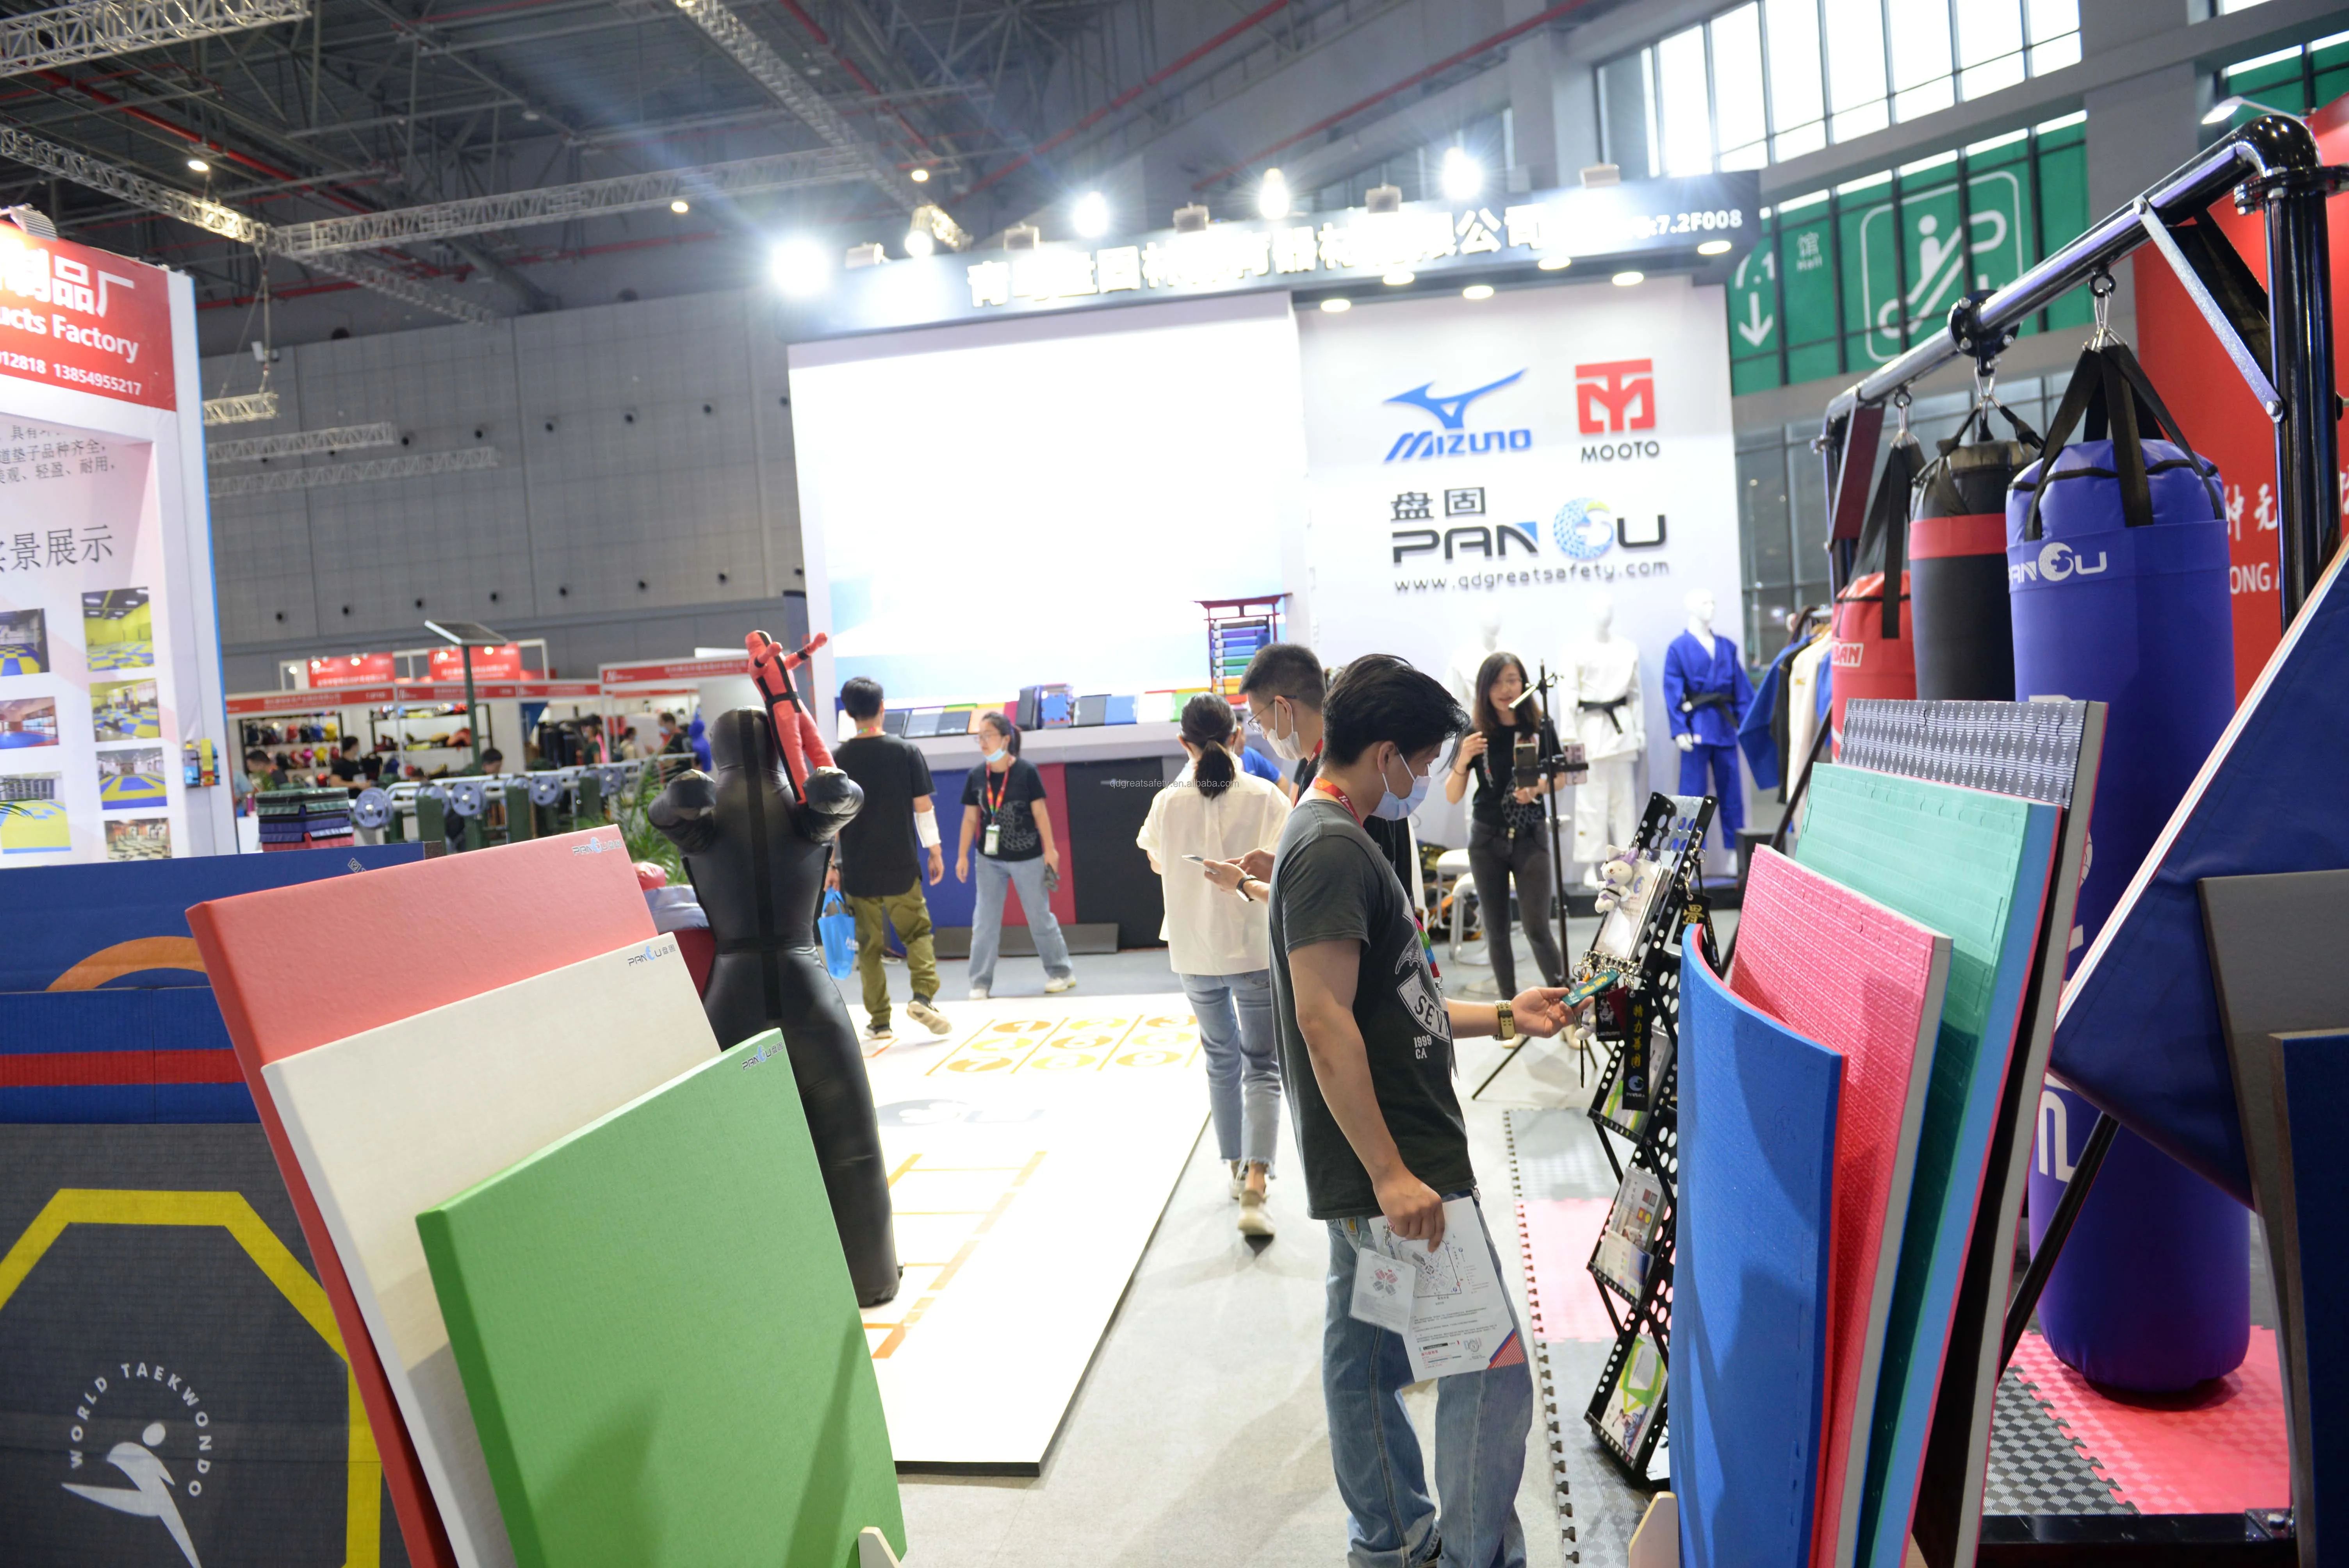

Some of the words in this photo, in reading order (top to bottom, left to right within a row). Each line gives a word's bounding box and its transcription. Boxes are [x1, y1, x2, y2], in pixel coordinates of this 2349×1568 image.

[52, 314, 139, 363] Factory
[0, 351, 46, 374] 12818
[53, 363, 142, 395] 13854955217
[1581, 441, 1660, 463] MOOTO
[1391, 486, 1486, 521] 盘固
[0, 524, 113, 573] 景展示
[1395, 560, 1670, 593] www.qdgreatsafety.com
[1413, 1035, 1432, 1048] 1999
[1415, 1048, 1428, 1060] CA
[69, 1376, 108, 1469] WORLD
[120, 1362, 212, 1497] TAEKWONDO
